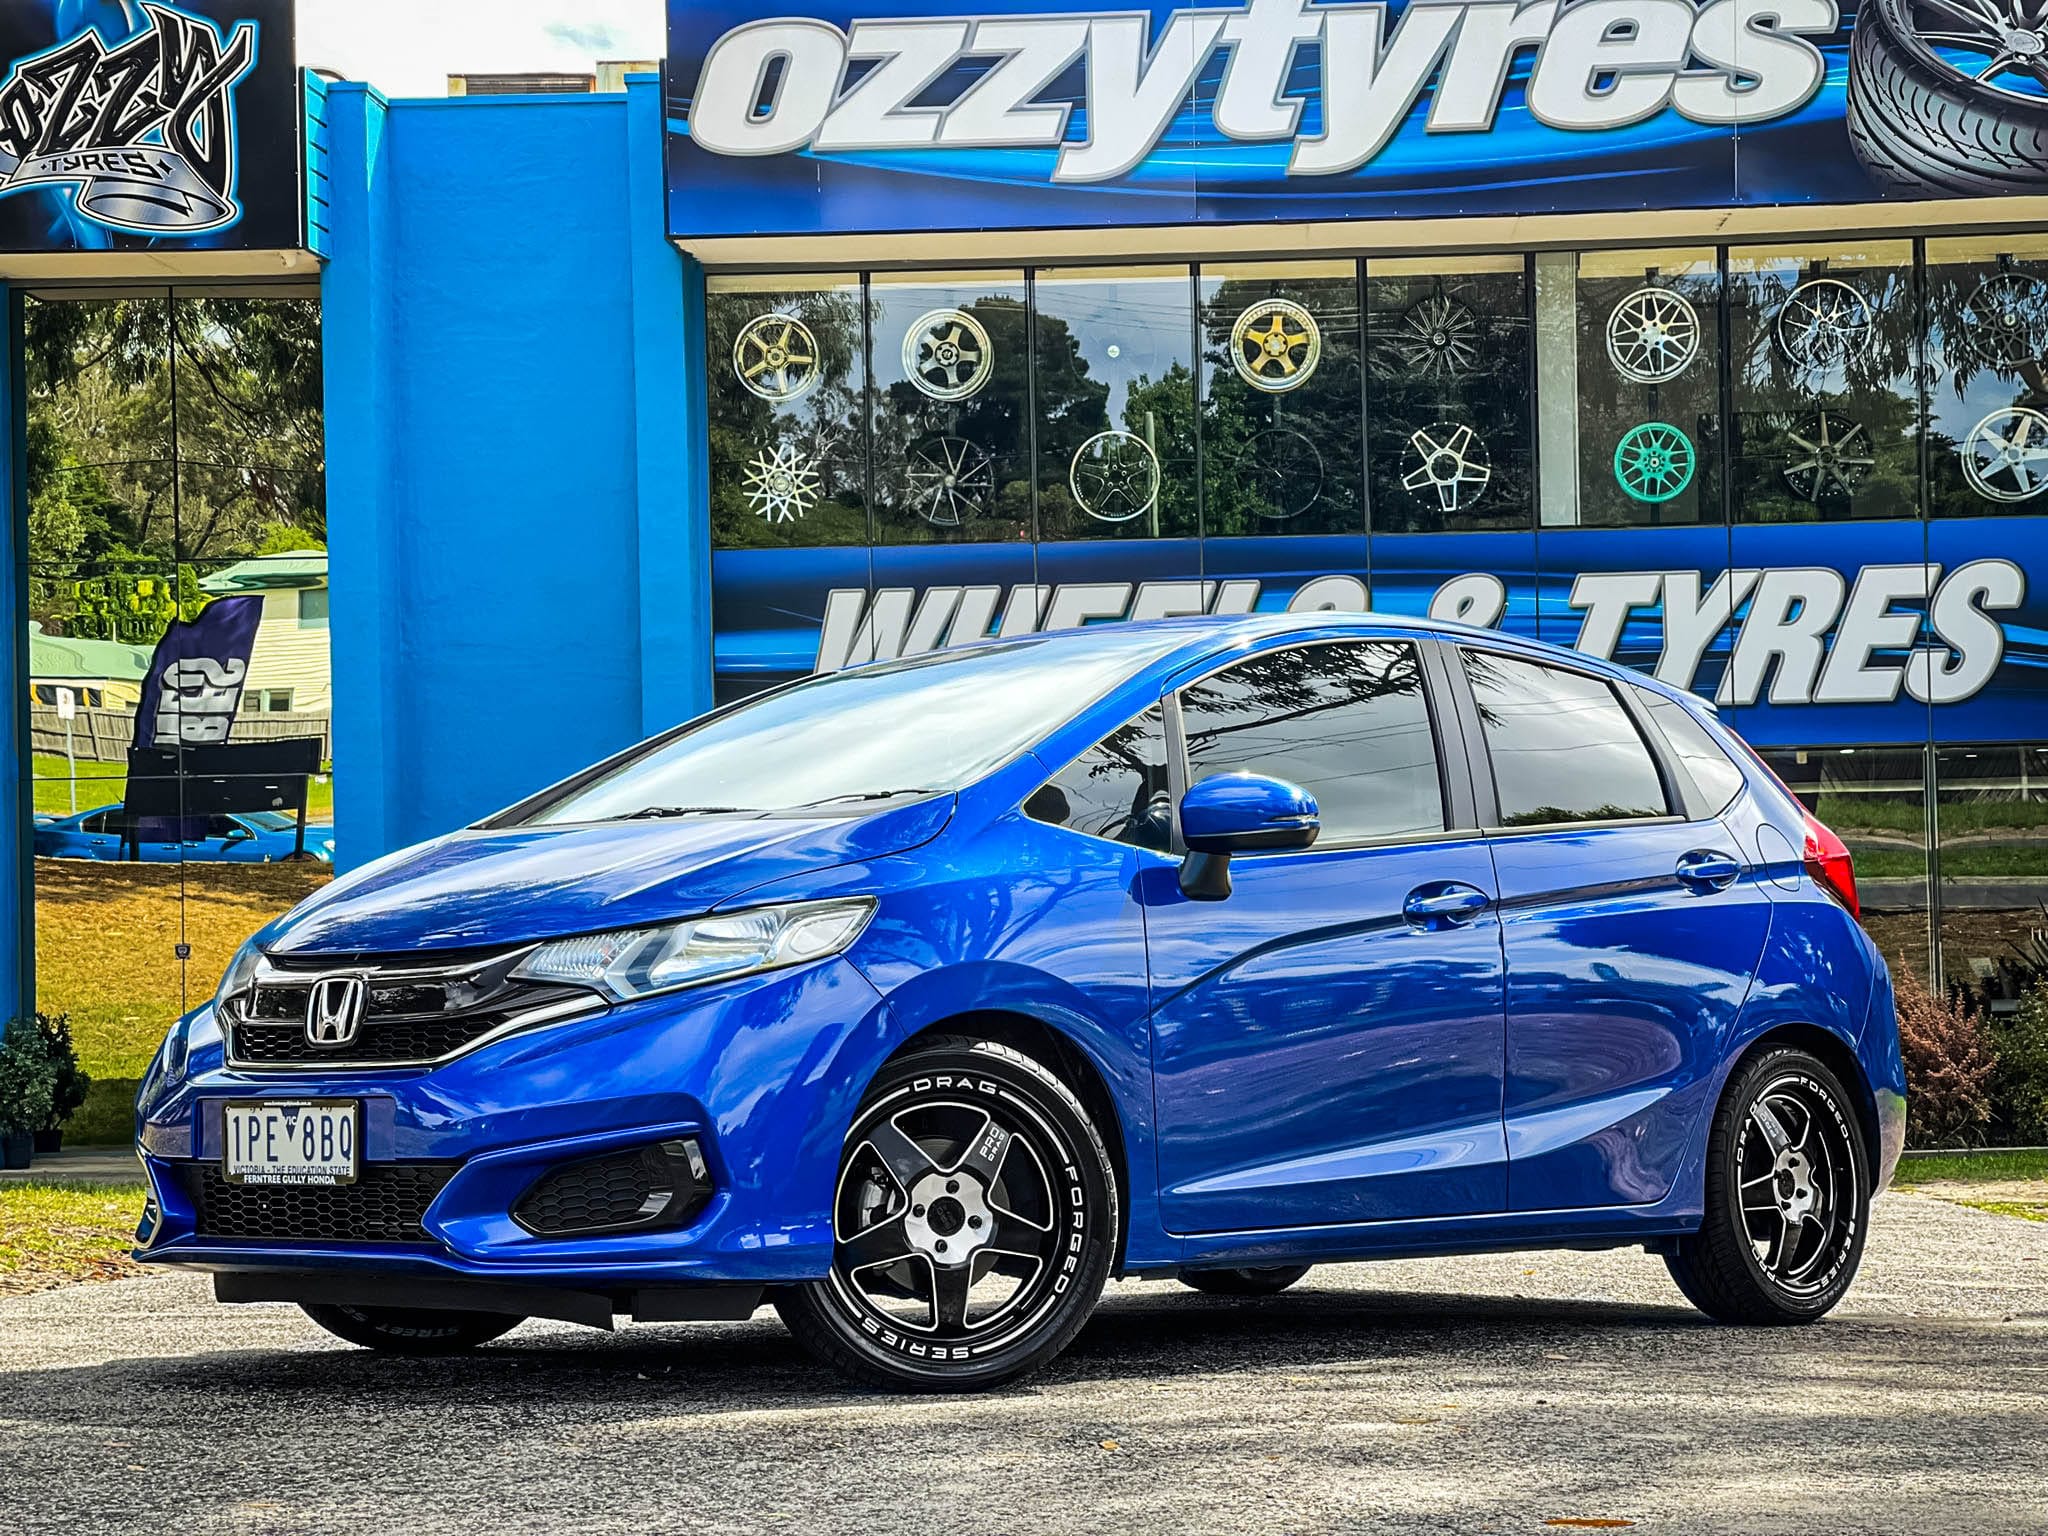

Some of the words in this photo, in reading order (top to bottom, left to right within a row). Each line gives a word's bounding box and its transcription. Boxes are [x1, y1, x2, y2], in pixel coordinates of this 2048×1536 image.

[688, 0, 1839, 182] ozzytyres
[48, 152, 163, 180] TYRES
[1569, 558, 2026, 705] TYRES
[913, 1076, 999, 1095] DRAG
[1801, 1077, 1849, 1139] FORGED
[233, 1115, 279, 1162] 1PE
[303, 1115, 352, 1162] 8BQ
[979, 1126, 1000, 1158] PRO
[987, 1132, 1006, 1162] DRAG
[233, 1165, 265, 1175] VICTORIA
[272, 1165, 286, 1175] THE
[287, 1166, 327, 1176] EDUCATION
[328, 1166, 351, 1177] STATE
[243, 1174, 281, 1184] FERNTREE
[282, 1175, 305, 1184] GULLY
[307, 1175, 336, 1185] HONDA
[1055, 1166, 1084, 1294] FORGED
[861, 1316, 970, 1359] SERIES
